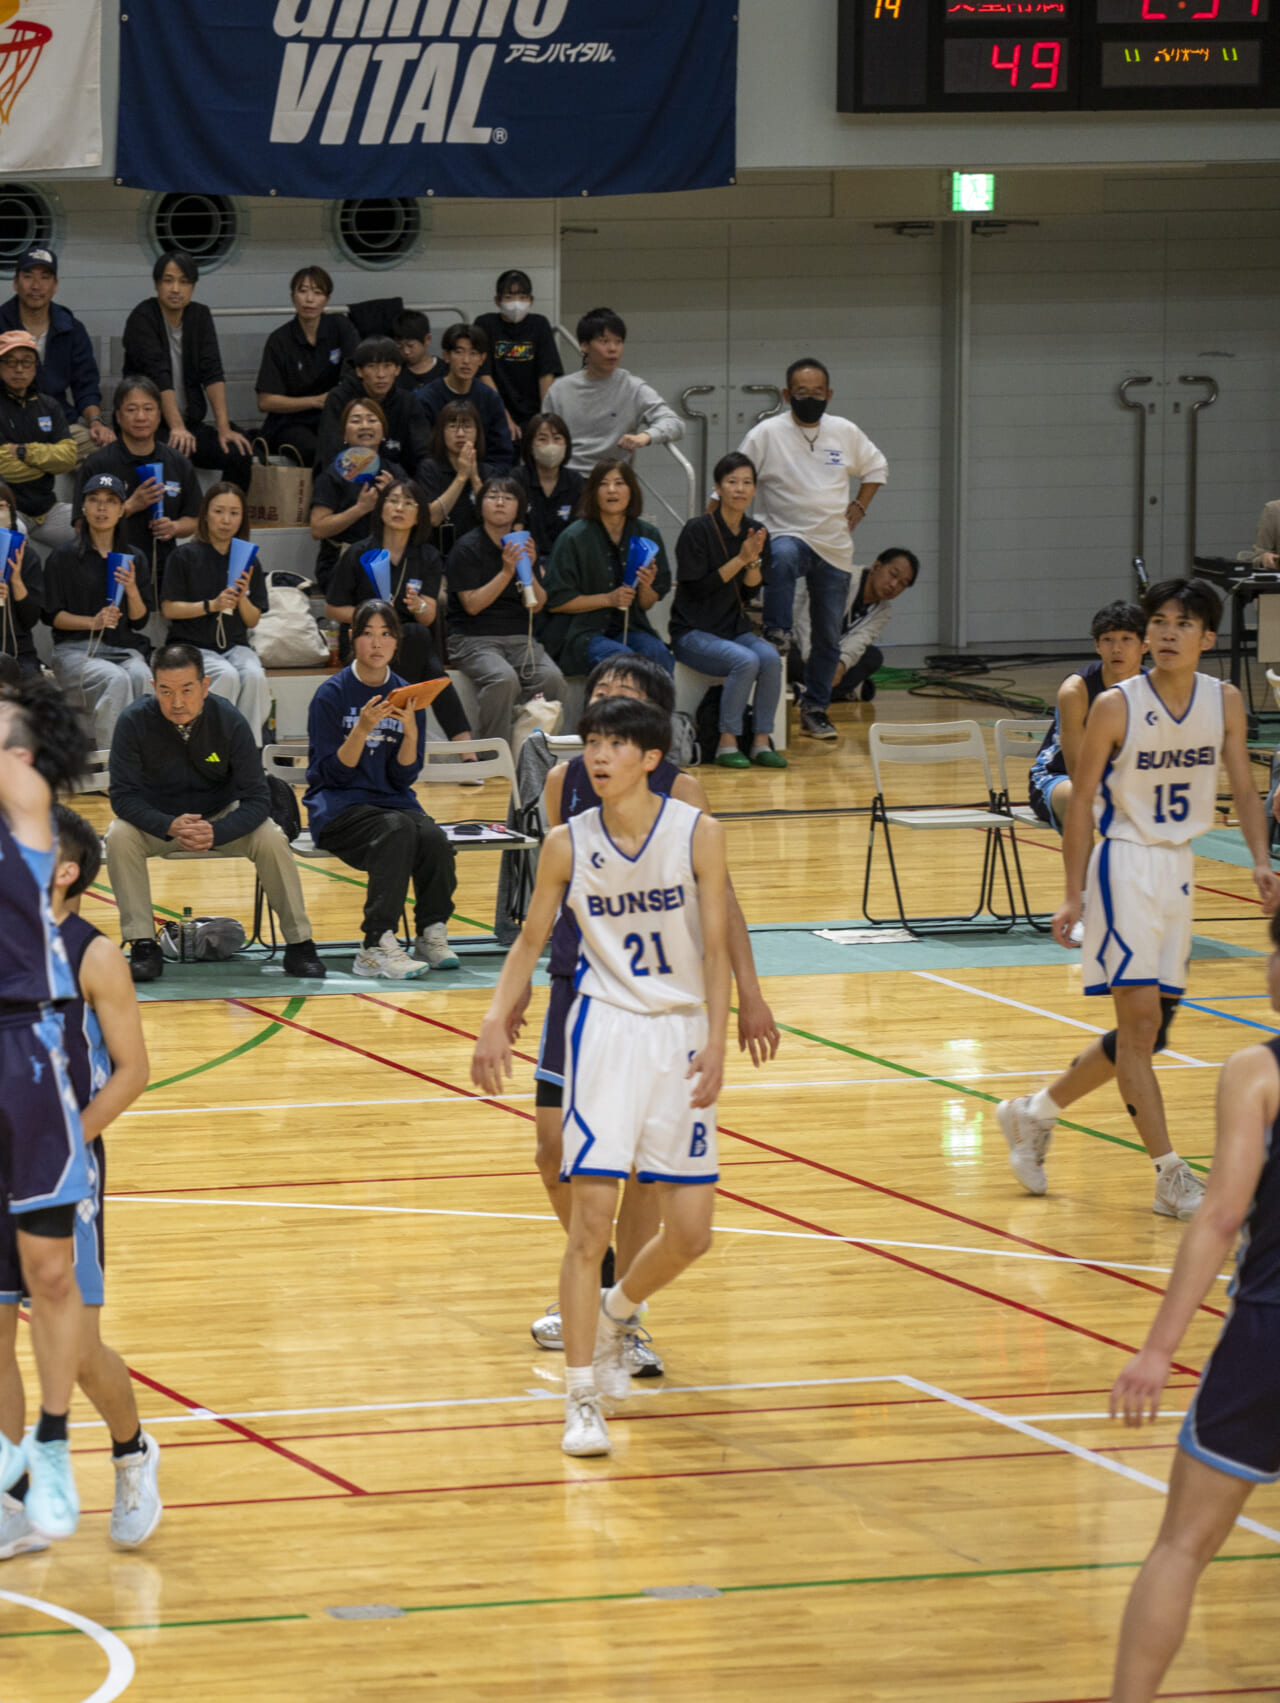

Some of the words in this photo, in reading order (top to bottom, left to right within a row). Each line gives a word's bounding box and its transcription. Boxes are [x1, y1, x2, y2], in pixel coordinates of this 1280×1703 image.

[992, 42, 1060, 89] 49
[1136, 746, 1215, 770] BUNSEI
[1153, 782, 1191, 823] 15
[587, 885, 685, 916] BUNSEI
[623, 931, 673, 977] 21
